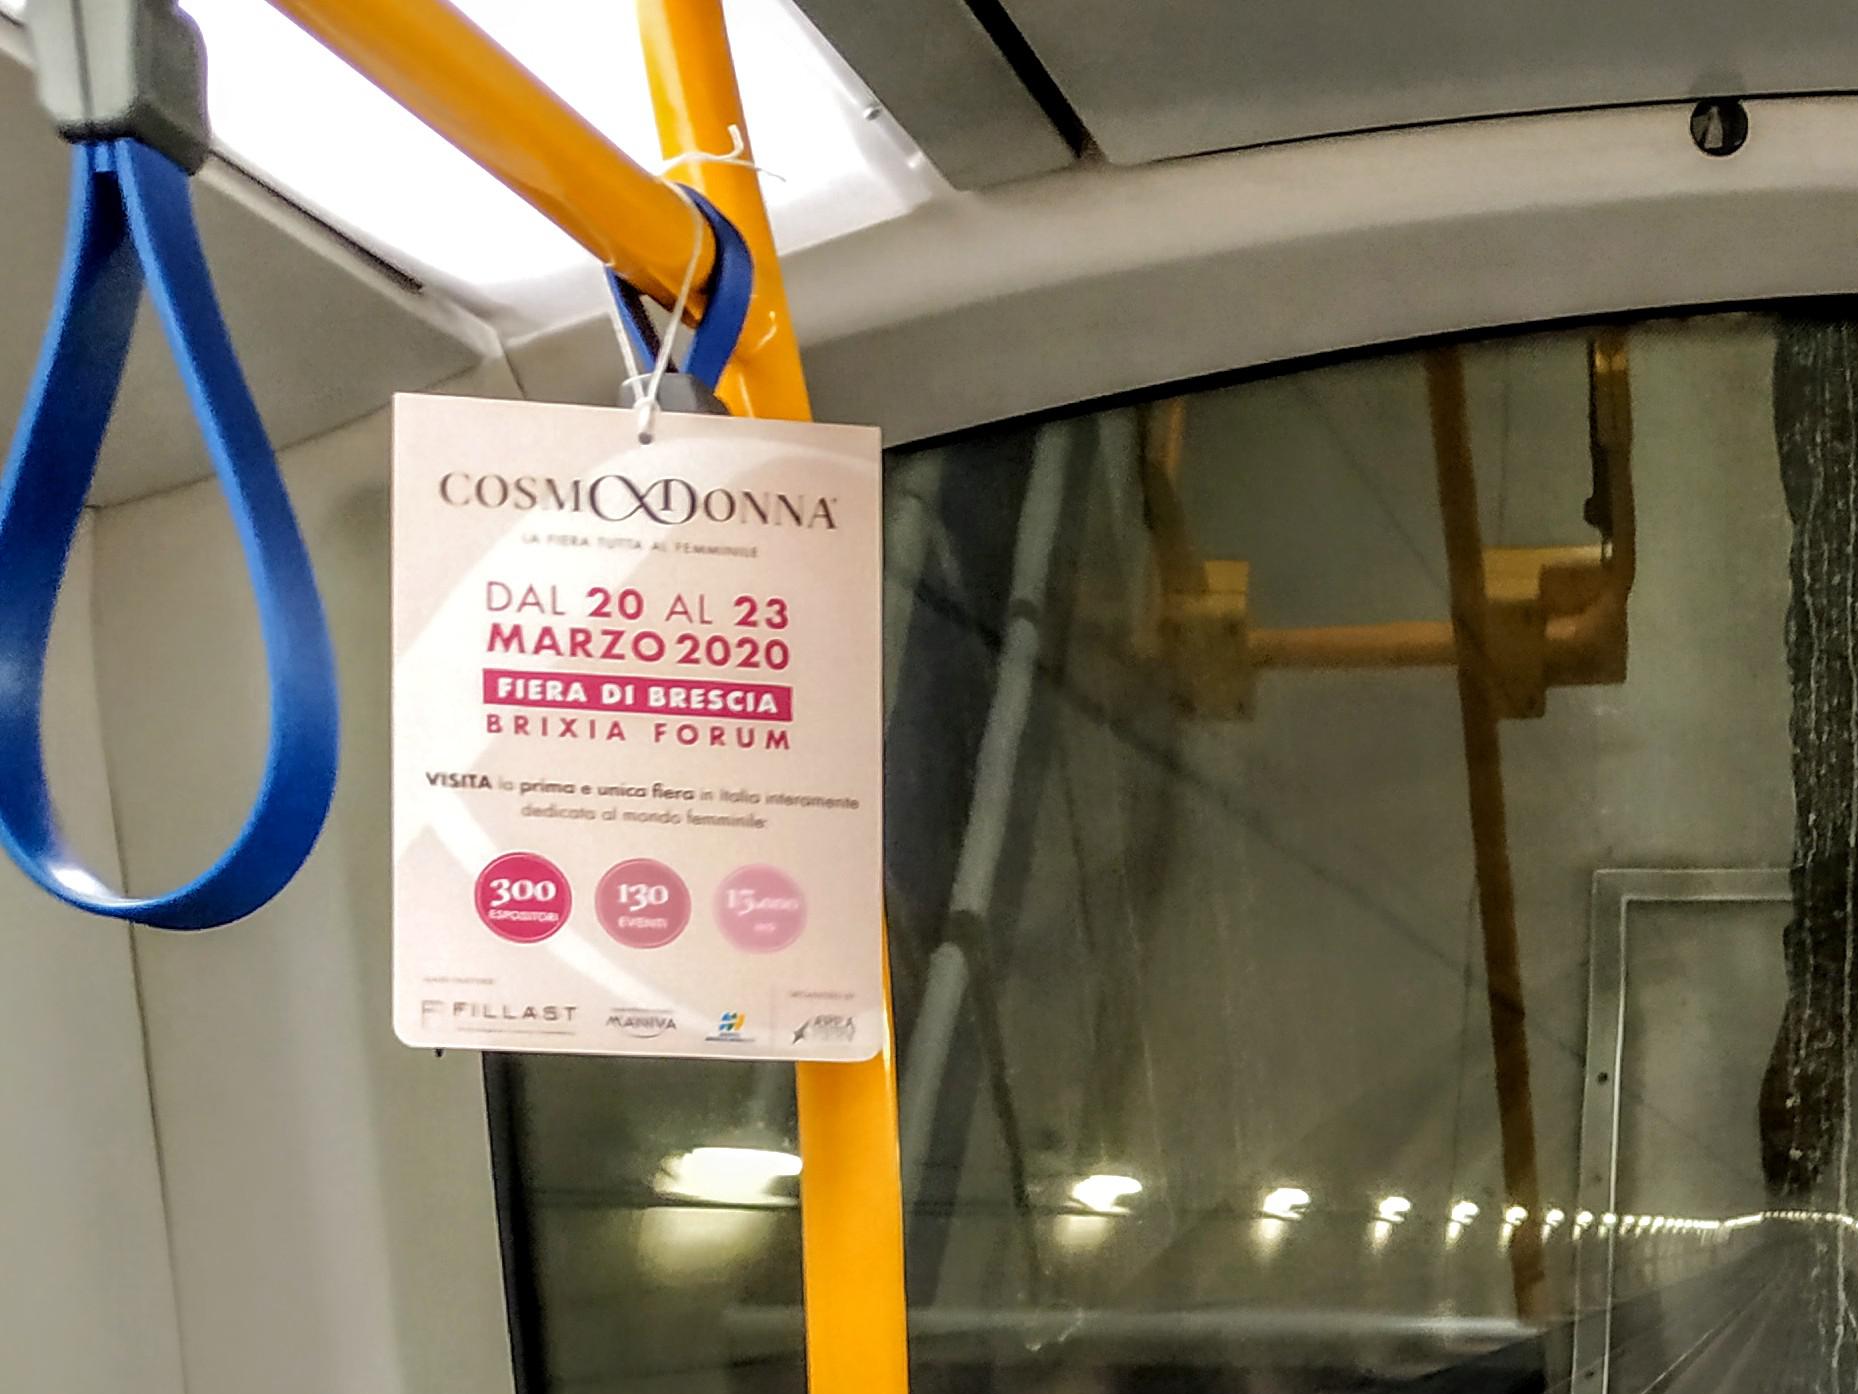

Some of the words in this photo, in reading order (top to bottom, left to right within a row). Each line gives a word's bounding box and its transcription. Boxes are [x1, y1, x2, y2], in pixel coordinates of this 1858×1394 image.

[547, 534, 590, 547] FIERA
[486, 581, 566, 616] DAL
[585, 586, 645, 620] 20
[664, 594, 713, 625] AL
[733, 595, 789, 630] 23
[486, 623, 666, 663] MARZO
[676, 633, 790, 671] 2020
[497, 677, 588, 703] FIERA
[602, 680, 634, 706] DI
[648, 686, 778, 714] BRESCIA
[486, 714, 627, 743] BRIXIA
[653, 723, 790, 751] FORUM
[425, 772, 492, 790] VISITA
[519, 779, 576, 795] prima
[580, 784, 592, 796] e
[598, 784, 647, 798] unica
[652, 782, 695, 801] fiera
[623, 809, 681, 825] mondo
[490, 879, 557, 907] 300
[617, 884, 669, 911] 130
[453, 1002, 578, 1021] FILLAST
